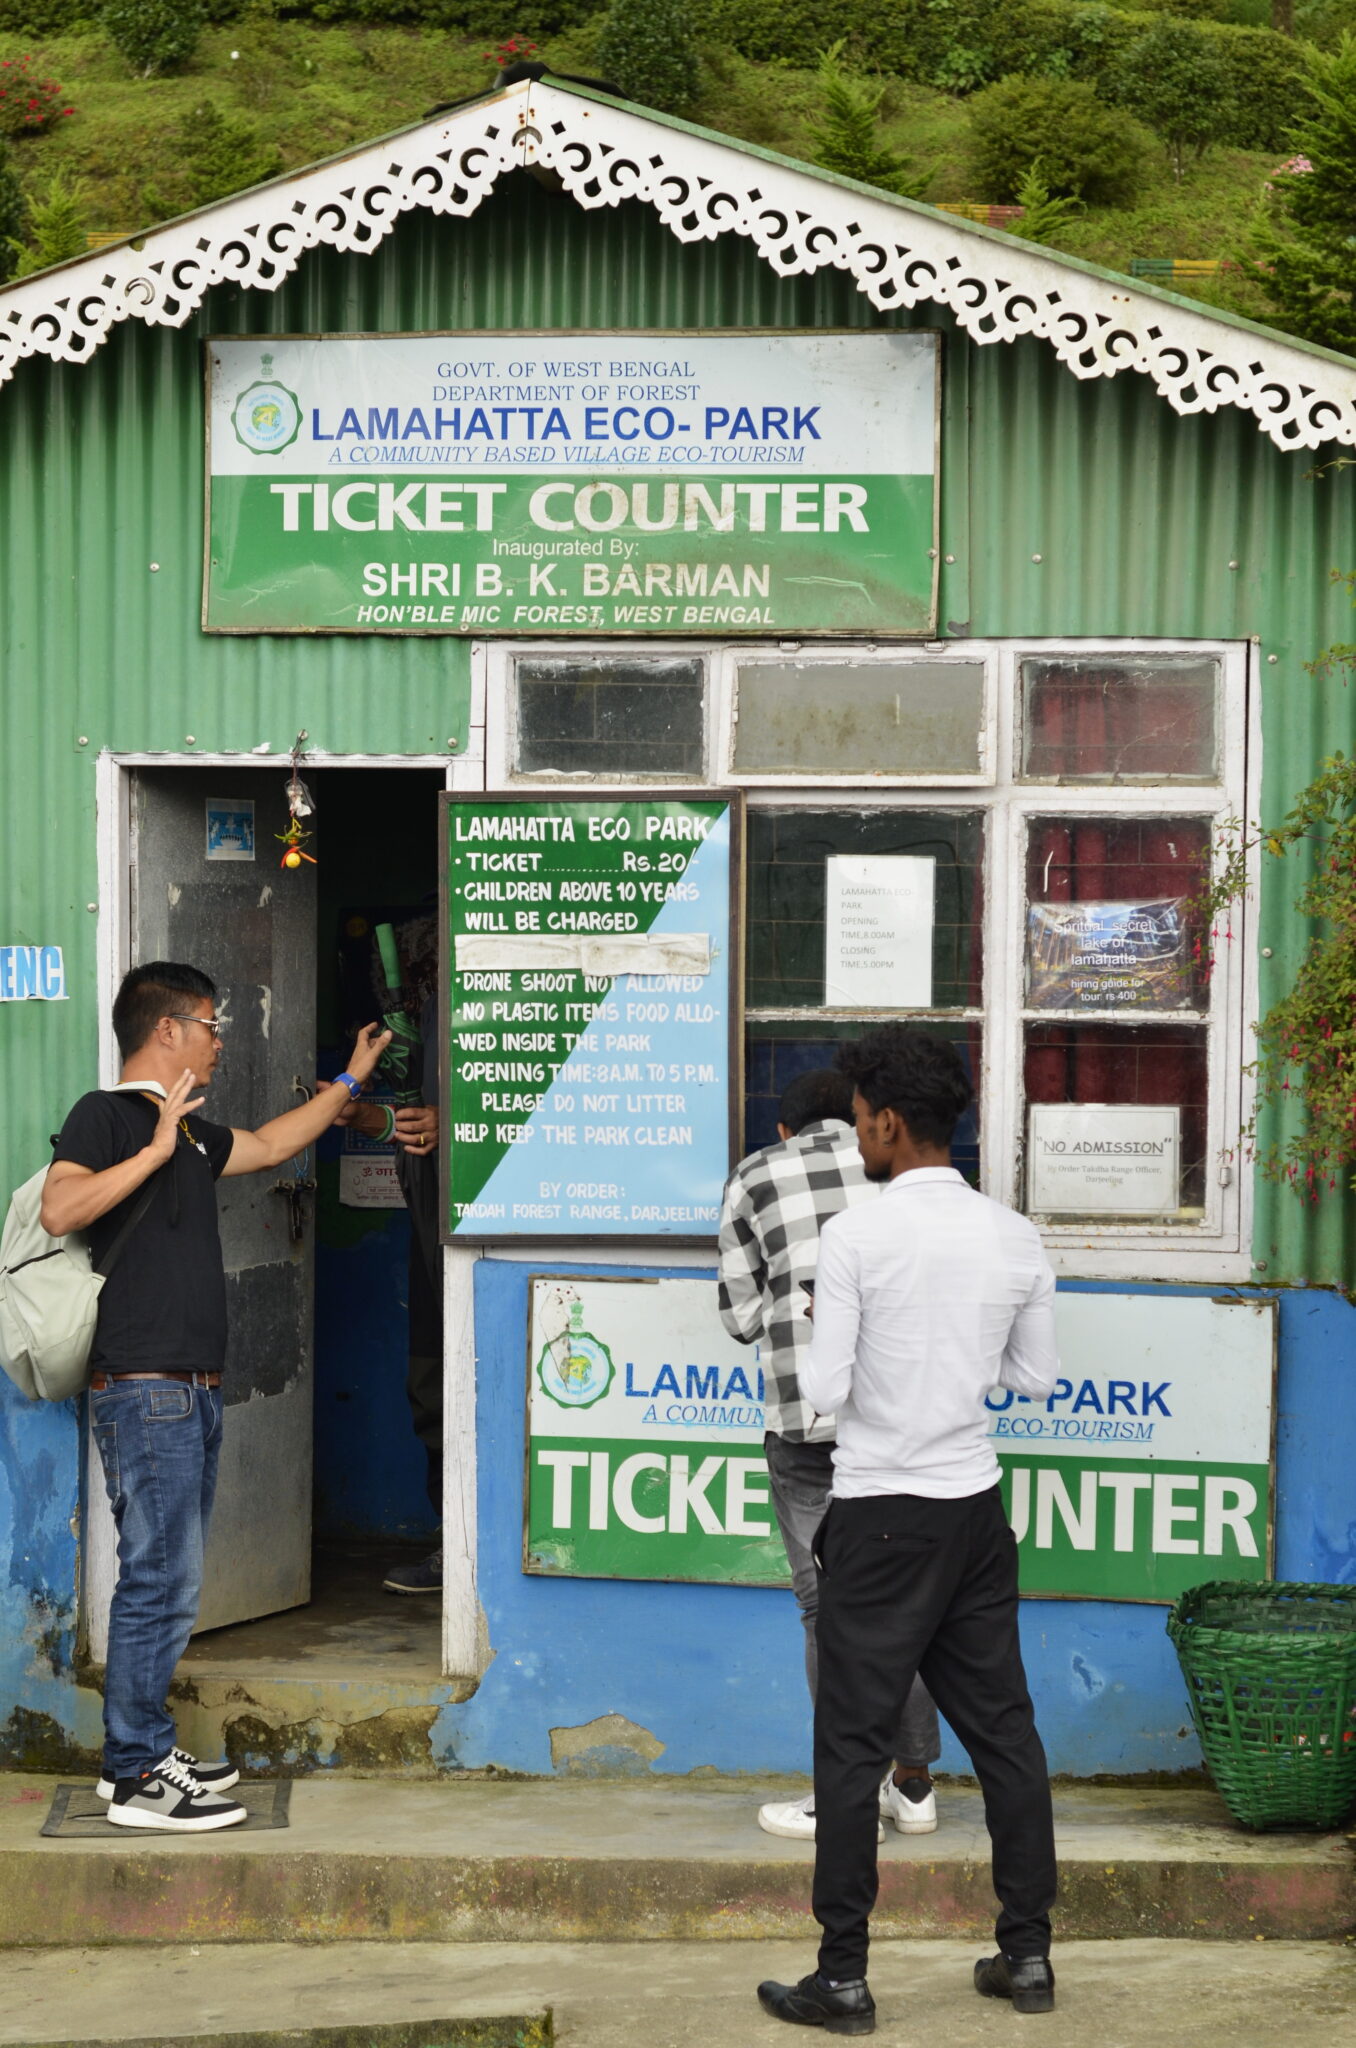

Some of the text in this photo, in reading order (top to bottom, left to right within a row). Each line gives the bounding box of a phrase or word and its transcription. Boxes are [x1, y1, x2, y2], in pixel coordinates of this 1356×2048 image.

[437, 361, 695, 378] GOVT. OF WEST BENGAL
[433, 384, 701, 401] DEPARTMENT OF FOREST
[312, 407, 572, 441] LAMAHATTA
[584, 406, 691, 440] ECO-
[705, 406, 822, 440] PARK
[329, 446, 806, 463] A COMMUNITY BASED VILLAGE ECO-TOURISM
[270, 481, 870, 533] TICKET COUNTER
[493, 538, 639, 559] Inaugurated By:
[362, 562, 770, 597] SHRI B. K. BARMAN
[462, 605, 501, 622] MIC
[513, 605, 605, 626] FOREST,
[613, 606, 676, 623] WEST
[684, 606, 775, 623] BENGAL
[455, 816, 711, 842] LAMAHATTA ECO PARK
[464, 881, 700, 902] CHILDREN ABOVE 10 YEARS
[841, 887, 892, 896] LAMAHATTA
[465, 911, 638, 931] WILL BE CHARGED
[840, 917, 879, 925] OPENING
[1112, 920, 1152, 932] secret
[840, 947, 876, 955] CLOSING
[1081, 937, 1126, 948] lake of
[1071, 954, 1136, 965] lamahatta
[463, 973, 704, 992] DRONE SHOOT NOT ALLOWED
[1071, 979, 1145, 990] hiring guide for
[1080, 991, 1137, 1001] tour rs 400
[462, 1002, 720, 1023] NO PLASTIC ITEMS FOOD ALLO-
[502, 1033, 556, 1052] INSIDE
[562, 1033, 600, 1052] THE
[605, 1034, 651, 1052] PARK
[462, 1062, 545, 1083] OPENING
[647, 1064, 665, 1082] TO
[669, 1065, 681, 1082] 5
[685, 1065, 720, 1083] P.M.
[481, 1093, 686, 1113] PLEASE DO NOT LITTER
[454, 1123, 693, 1146] HELP KEEP THE PARK CLEAN
[1085, 1175, 1124, 1184] Darjeeling
[1111, 1166, 1133, 1174] Range
[539, 1182, 626, 1199] BY ORDER:
[454, 1203, 505, 1218] TAKDAH
[512, 1204, 562, 1219] FOREST
[632, 1206, 719, 1222] DARJEELING
[1046, 1378, 1172, 1418] PARK
[643, 1404, 1156, 1440] A COMMUN ECO-TOURISM
[538, 1450, 771, 1537] TICKE
